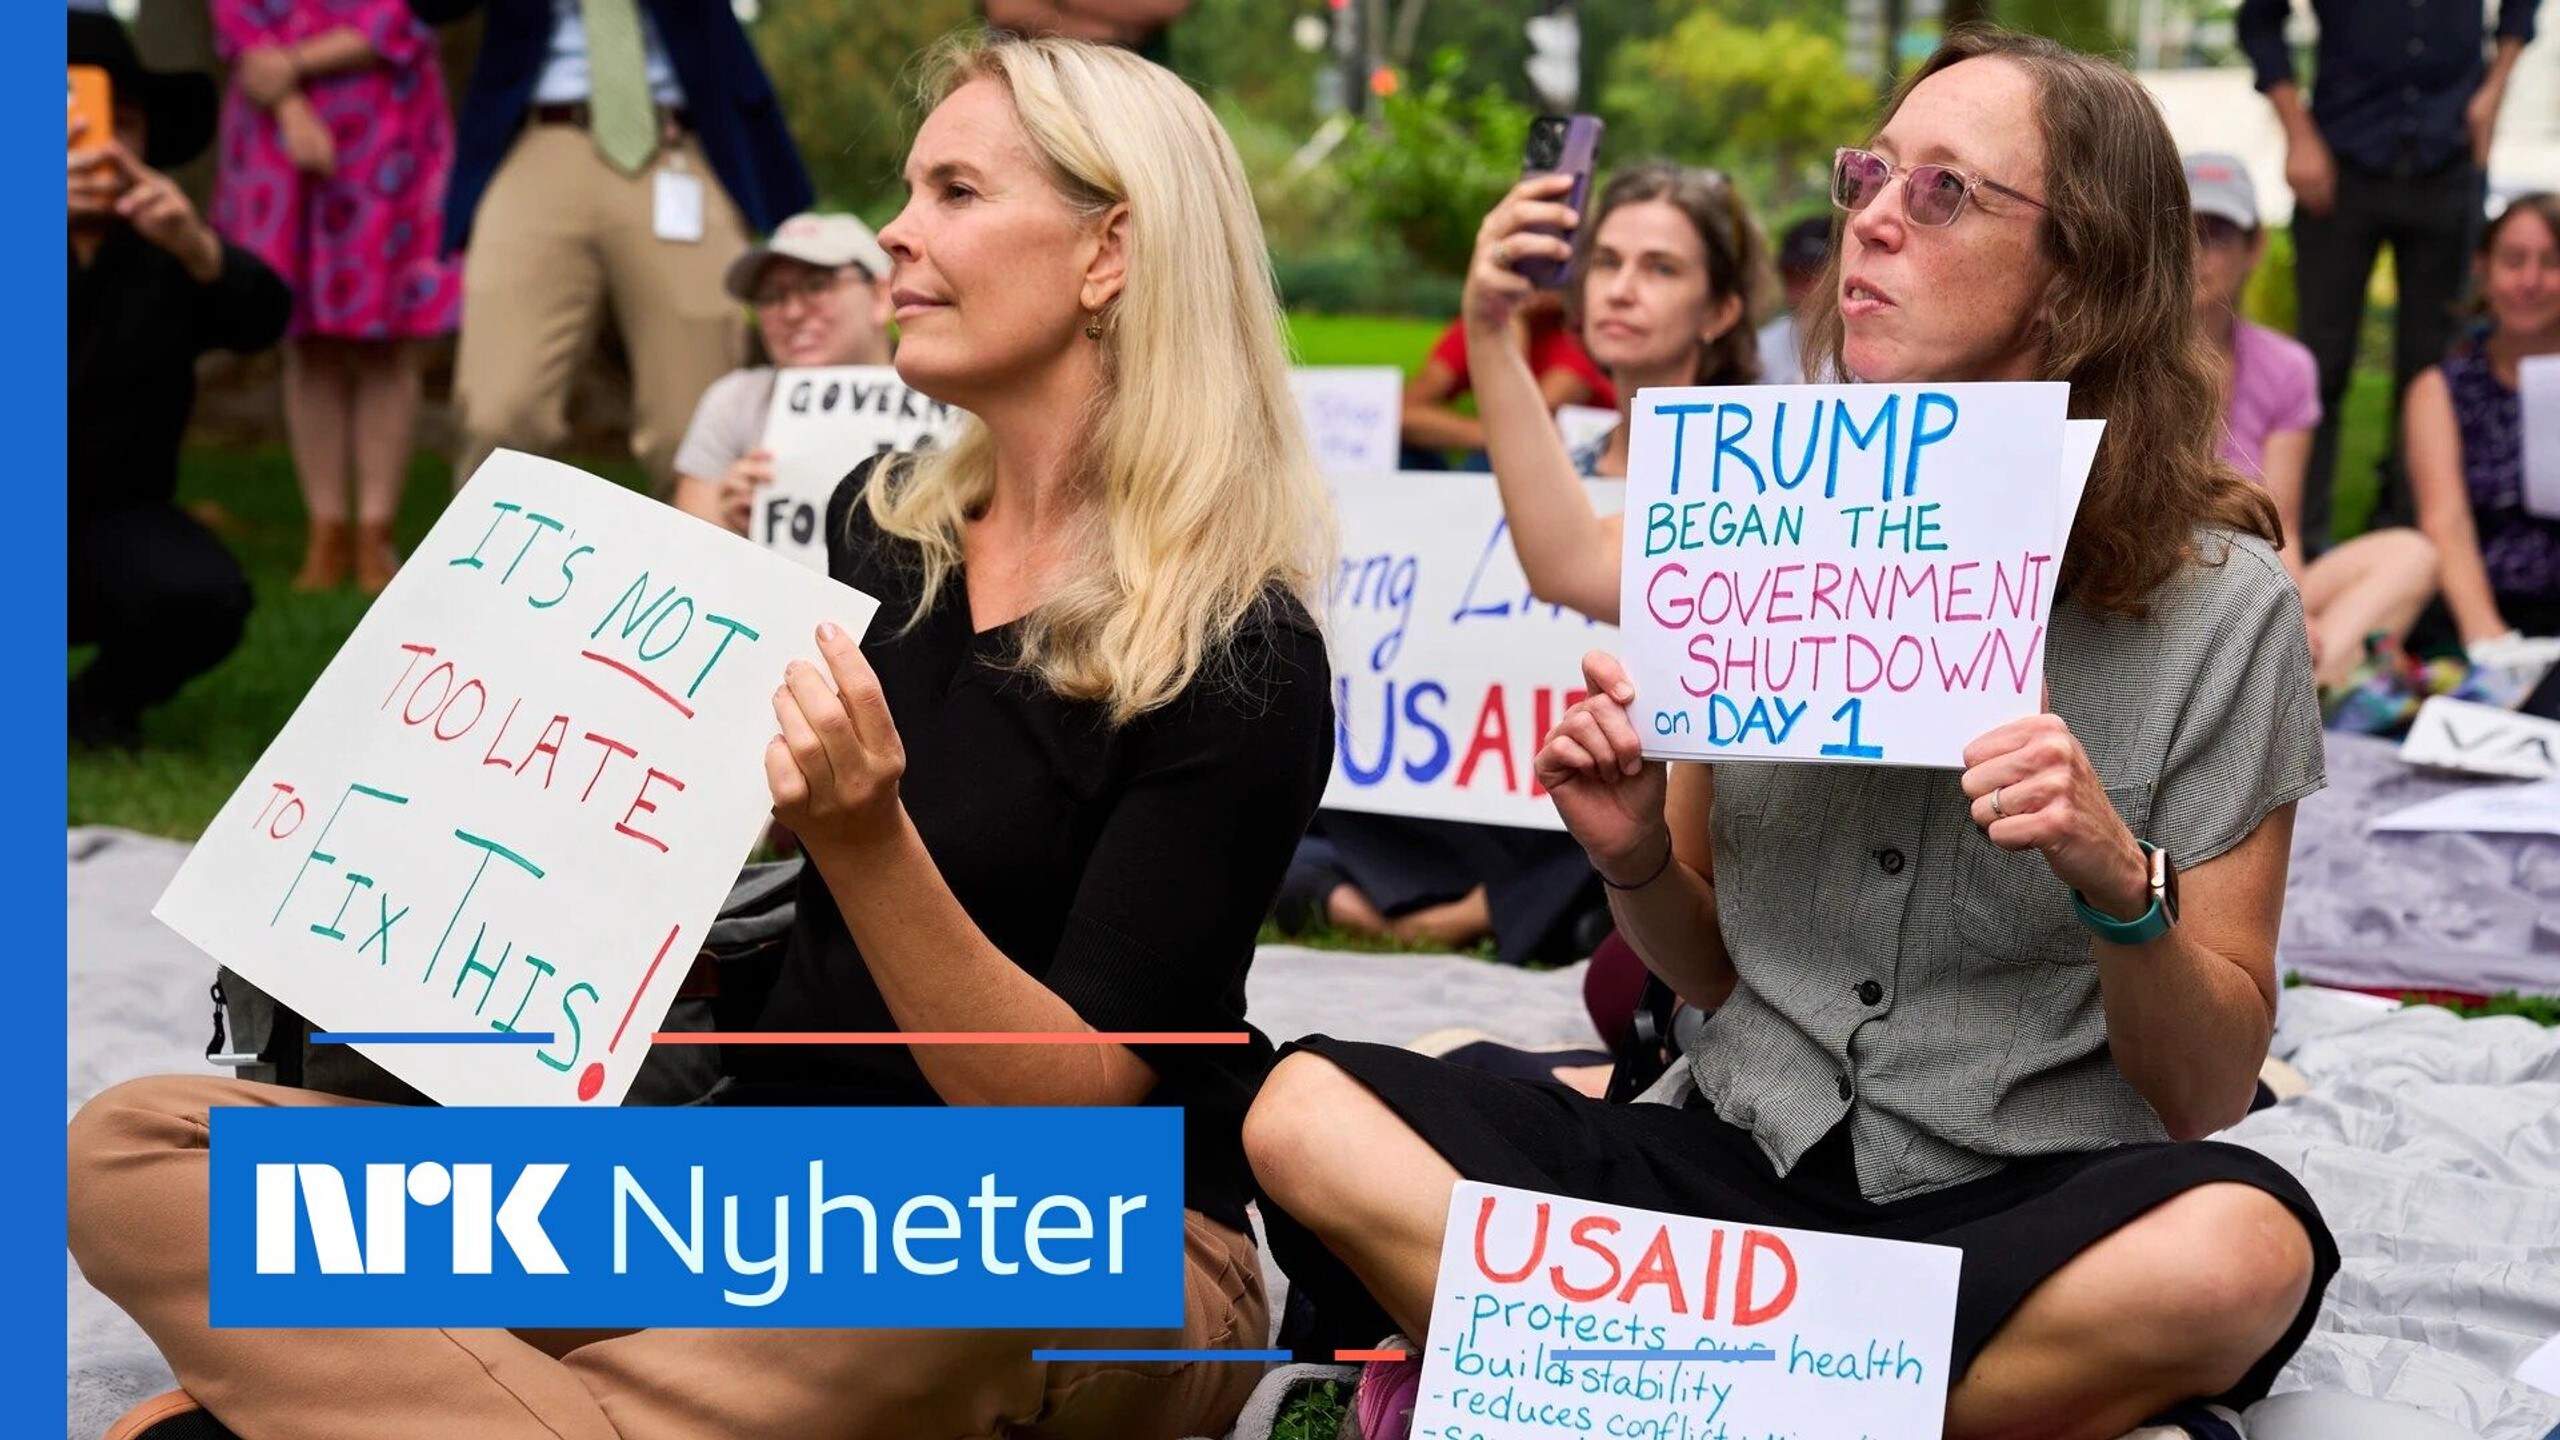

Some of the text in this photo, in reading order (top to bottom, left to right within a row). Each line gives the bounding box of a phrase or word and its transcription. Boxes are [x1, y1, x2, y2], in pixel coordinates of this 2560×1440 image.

[1655, 393, 1959, 502] TRUMP
[766, 499, 828, 545] FO
[1645, 502, 1949, 558] BEGAN THE
[450, 502, 759, 699] IT'S NOT
[1646, 551, 2052, 630] GOVERNMENT
[1680, 625, 2043, 698] SHUTDOWN
[381, 643, 686, 853] TOO LATE
[1336, 676, 1588, 798] USAI
[1655, 693, 1883, 759] on DAY 1
[252, 782, 306, 839] TO
[1474, 1196, 1799, 1327] USAID
[1582, 1353, 1733, 1424] stability
[1789, 1334, 1923, 1384] health
